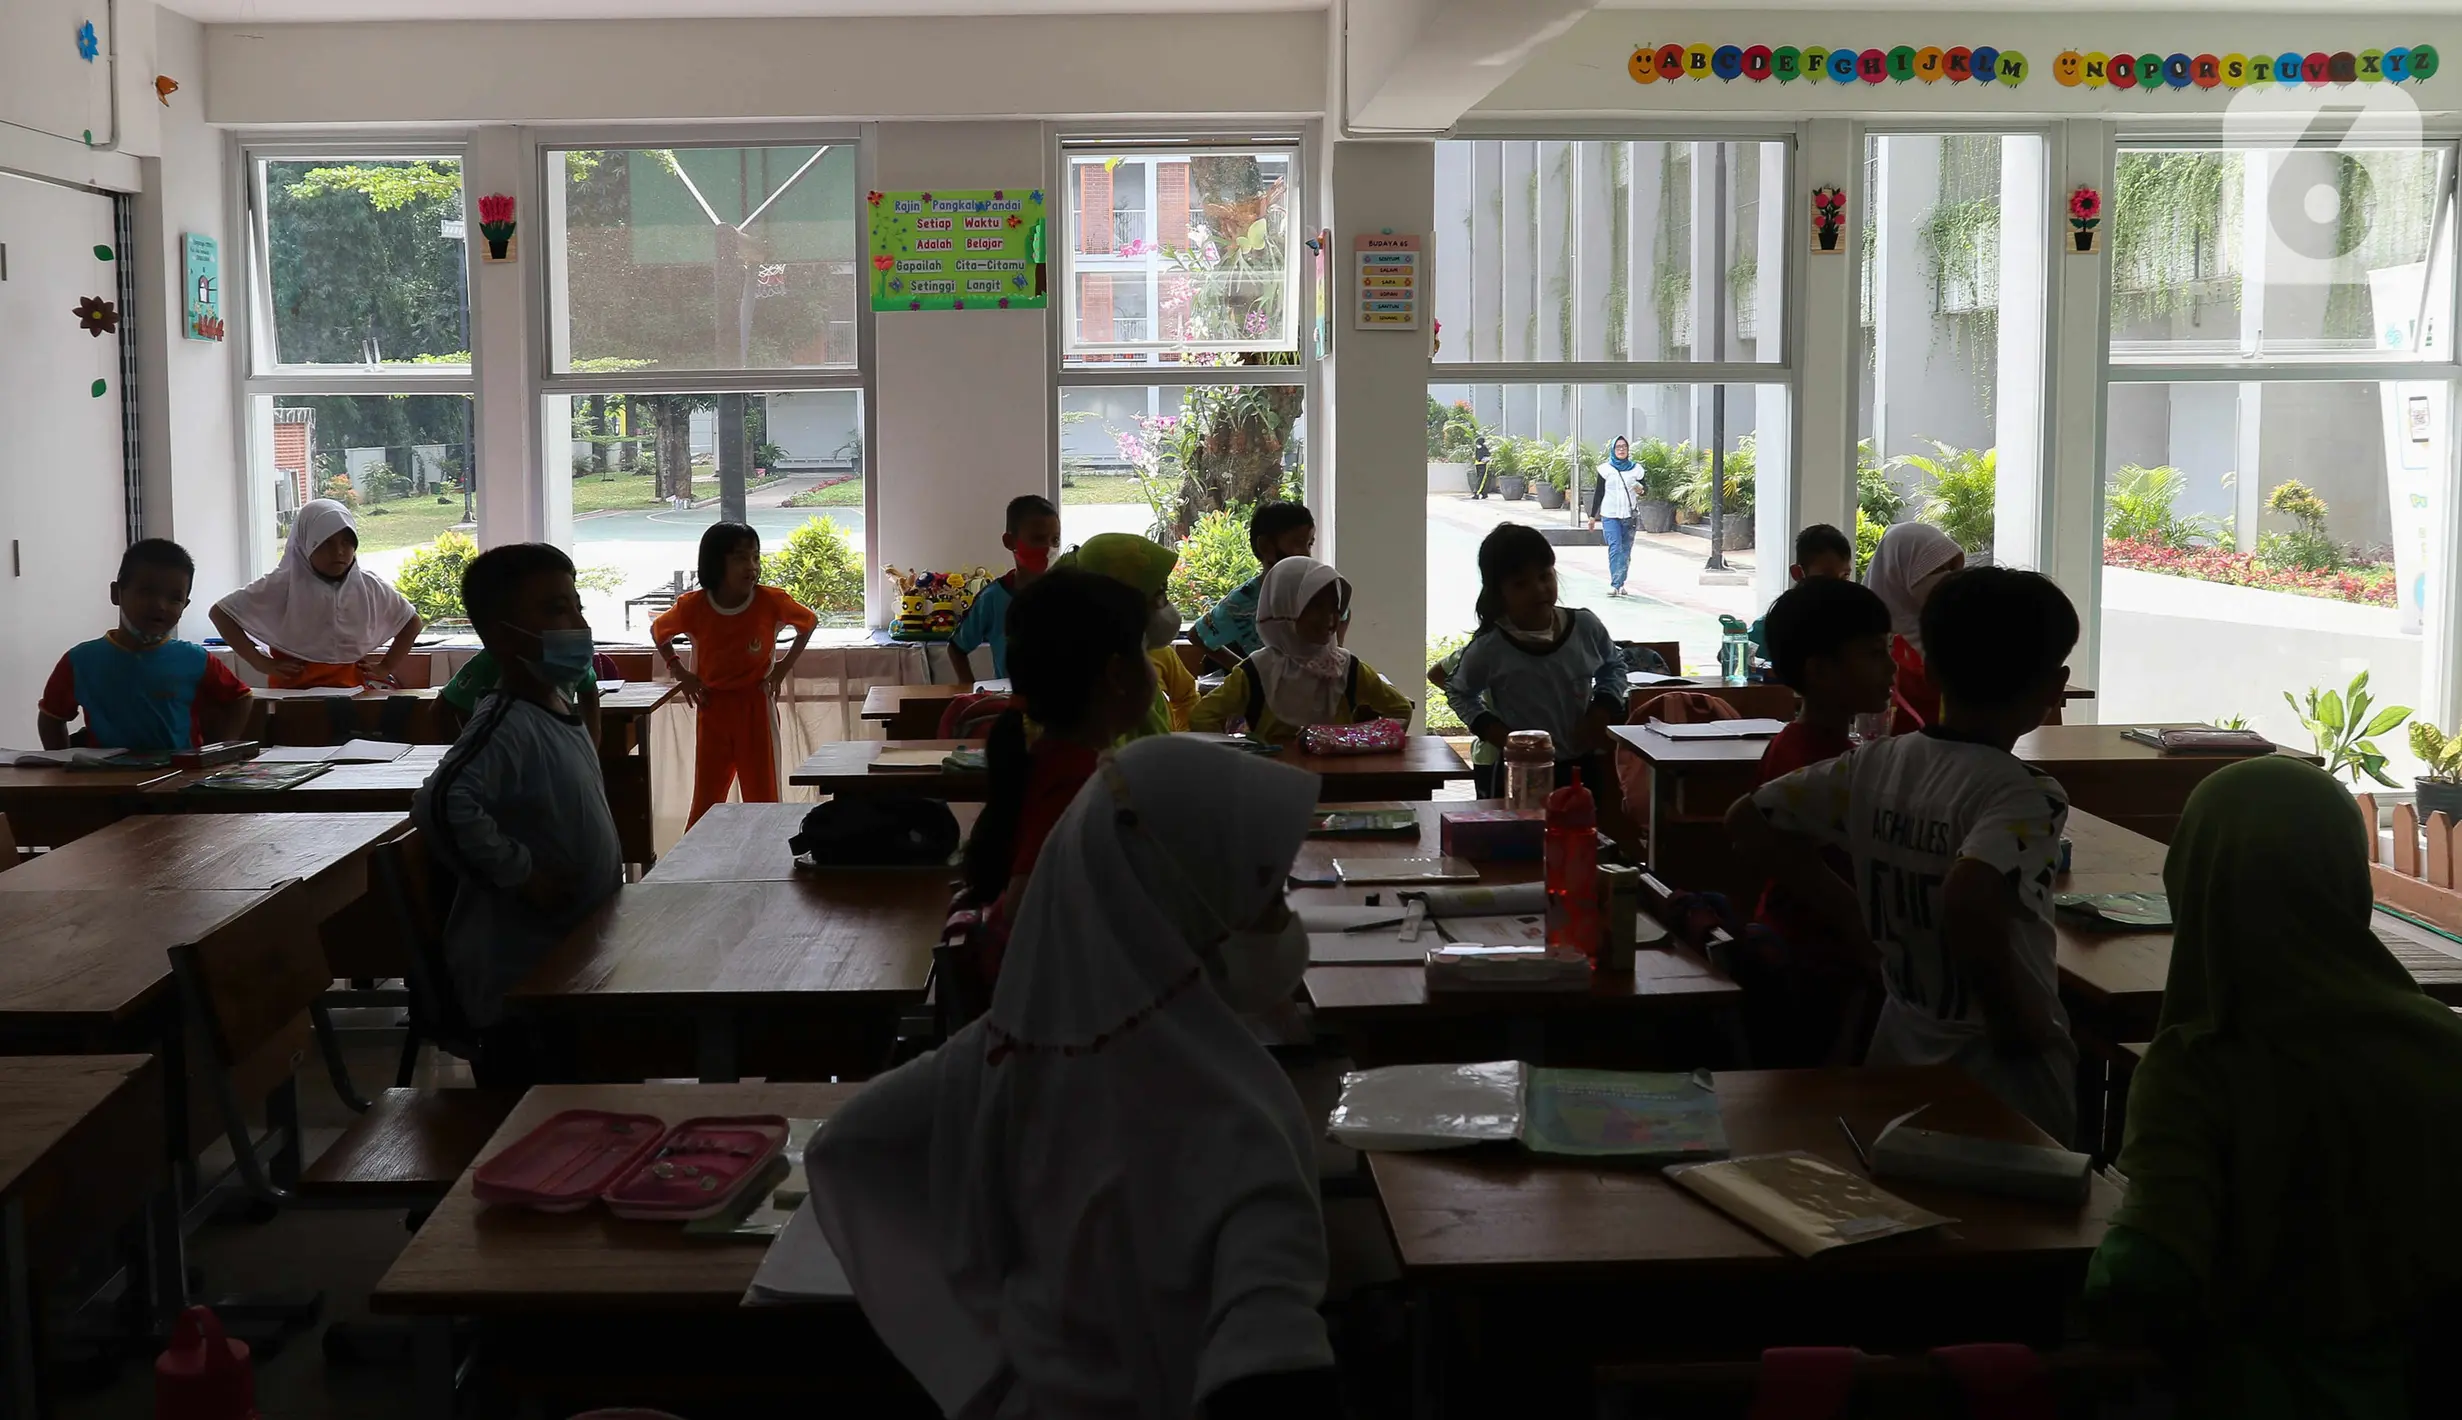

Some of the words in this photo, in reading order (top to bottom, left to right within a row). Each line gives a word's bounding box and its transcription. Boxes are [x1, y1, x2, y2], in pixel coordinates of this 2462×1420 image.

[895, 201, 920, 213] Rajin
[932, 200, 976, 213] Pangkal
[986, 200, 1021, 211] Pandai
[917, 218, 951, 231] Setiap
[964, 218, 999, 228] Waktu
[917, 239, 952, 249] Adalah
[966, 239, 1003, 250] Belajar
[896, 261, 942, 272] Gapailah
[911, 280, 955, 293] Setinggi
[966, 280, 1000, 292] Langit
[1872, 807, 1950, 856] ACHILLES
